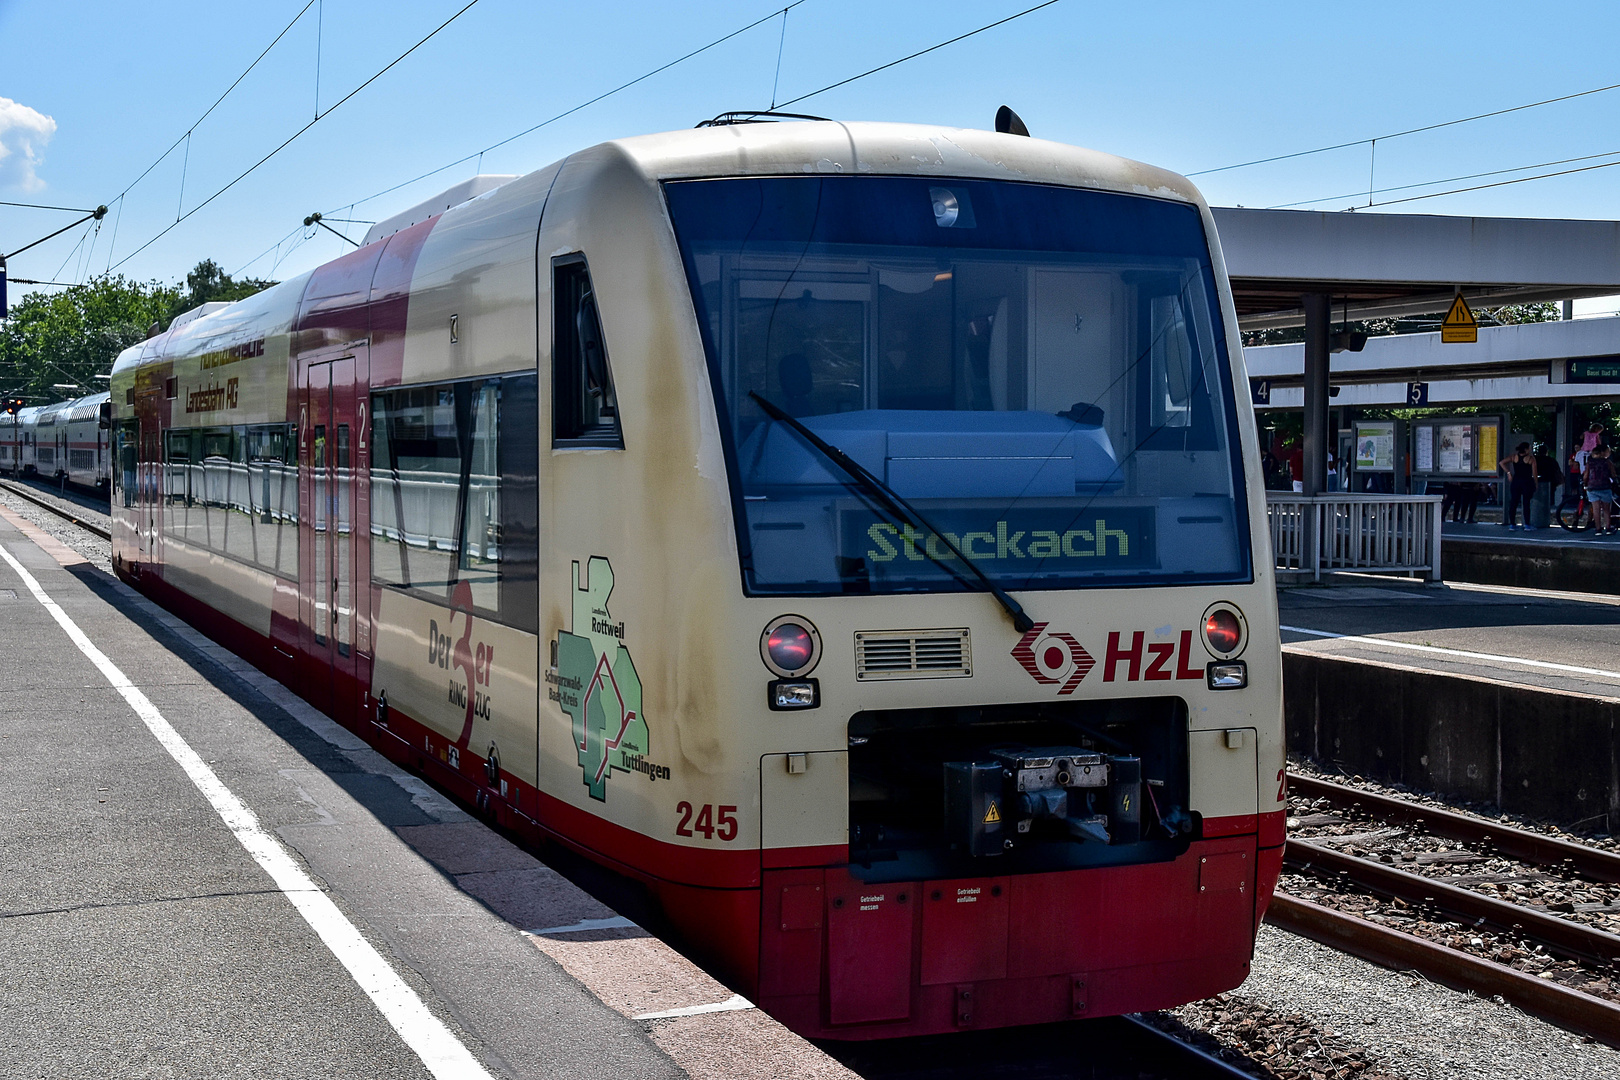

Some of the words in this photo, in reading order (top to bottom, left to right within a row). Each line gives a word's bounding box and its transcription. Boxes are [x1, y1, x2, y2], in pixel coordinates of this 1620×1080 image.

[1571, 362, 1577, 373] 4
[226, 377, 239, 409] AG
[1257, 382, 1268, 400] 4
[1411, 383, 1422, 401] 5
[301, 407, 306, 448] 2
[359, 402, 366, 449] 2
[867, 520, 1129, 561] Stockach
[428, 619, 451, 670] Der
[591, 617, 625, 639] Rottweil
[1103, 630, 1205, 682] HzL
[621, 752, 671, 782] Tuttlingen
[676, 801, 738, 841] 245
